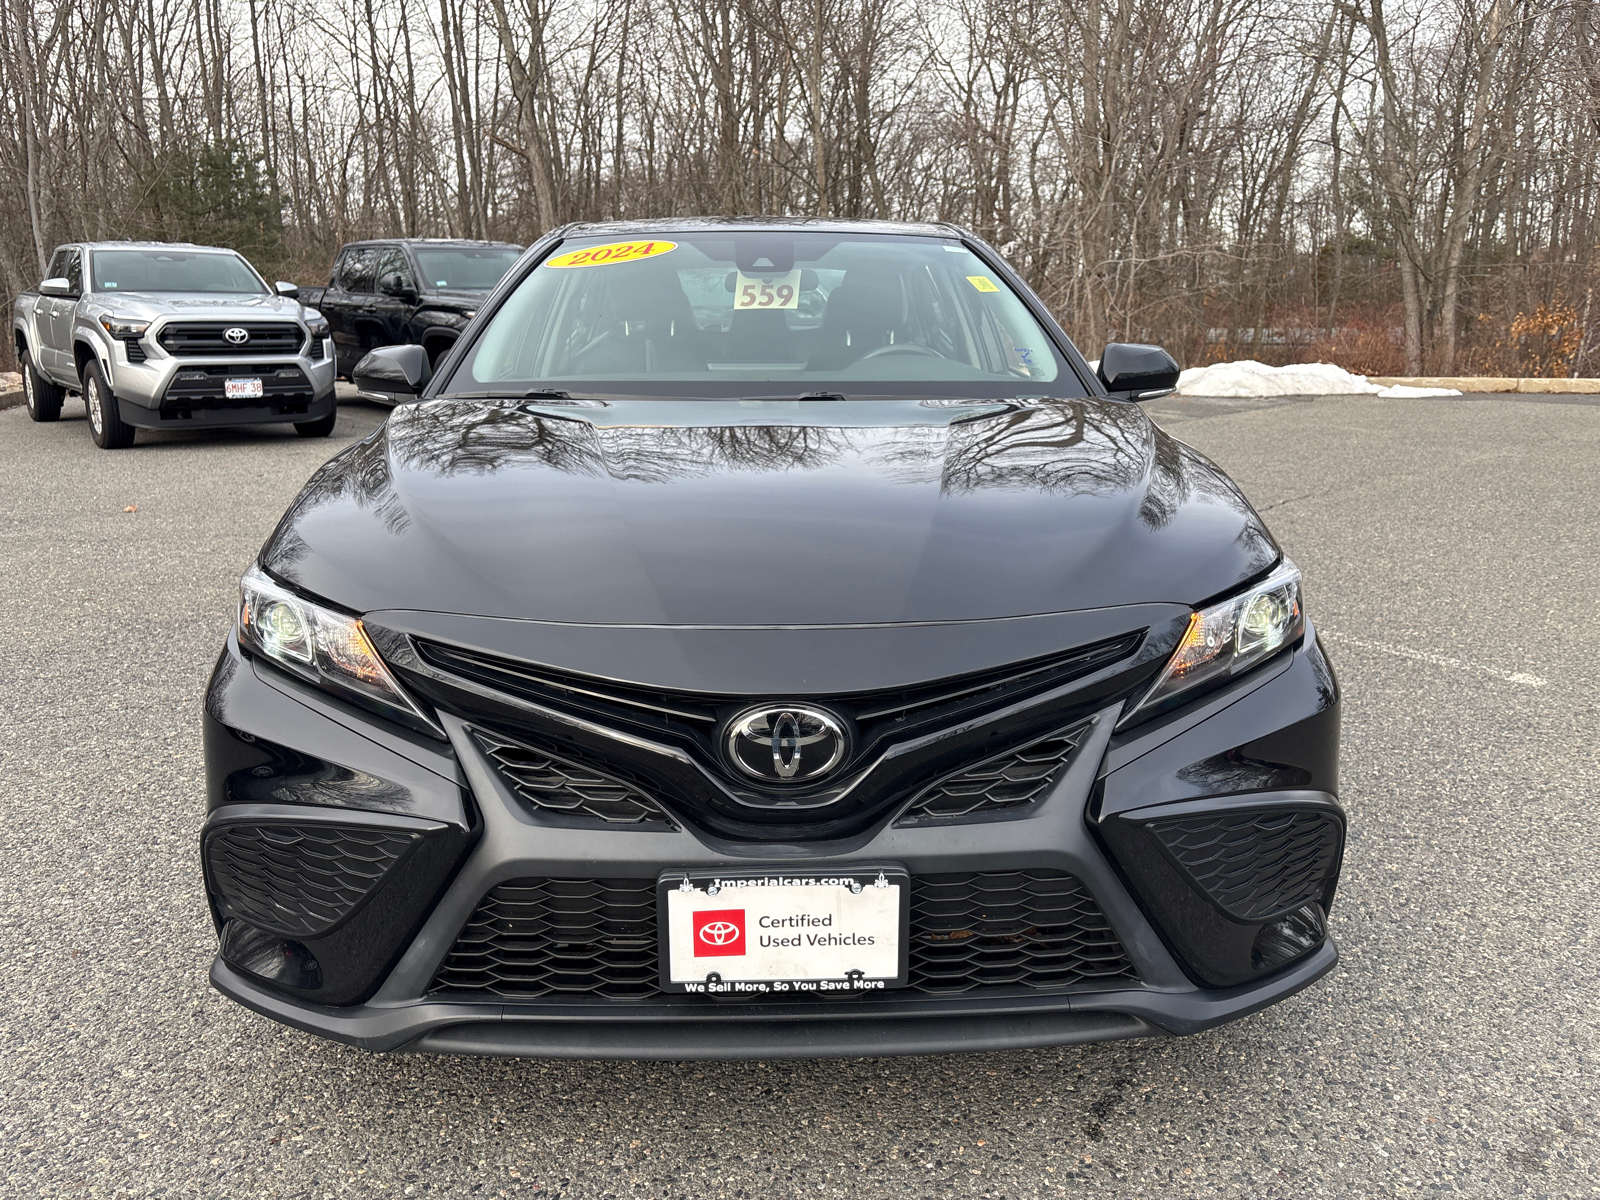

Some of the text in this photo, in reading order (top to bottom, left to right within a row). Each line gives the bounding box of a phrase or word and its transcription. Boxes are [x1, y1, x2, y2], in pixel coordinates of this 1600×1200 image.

[567, 242, 655, 266] 2024
[740, 284, 794, 307] 559
[714, 877, 854, 888] Imperialcars.com
[758, 913, 832, 928] Certified
[759, 932, 875, 947] Used Vehicles
[685, 978, 885, 992] We Sell More, So You Save More
